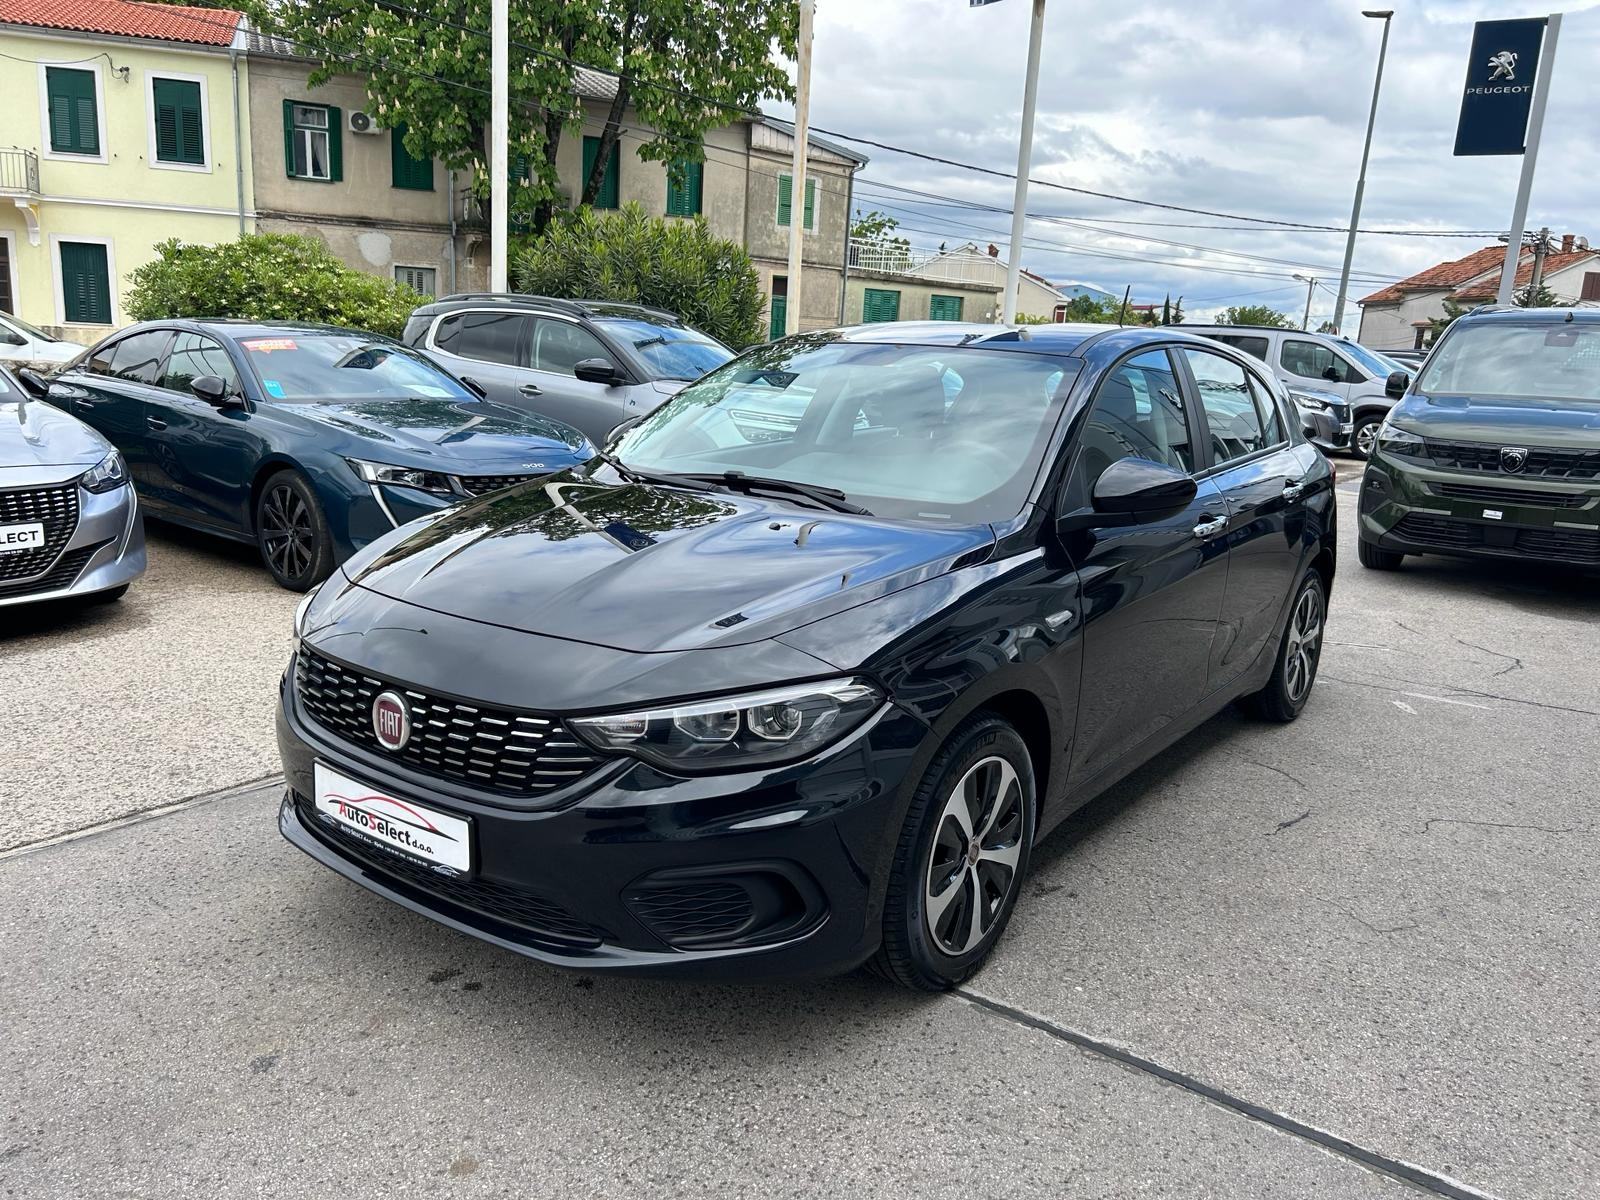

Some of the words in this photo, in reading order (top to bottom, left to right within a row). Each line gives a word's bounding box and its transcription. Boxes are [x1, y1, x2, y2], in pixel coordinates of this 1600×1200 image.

[1466, 86, 1531, 95] PEUGEOT
[380, 708, 401, 737] FIAT
[338, 801, 412, 846] AutoSelect
[412, 839, 435, 855] d.o.o.
